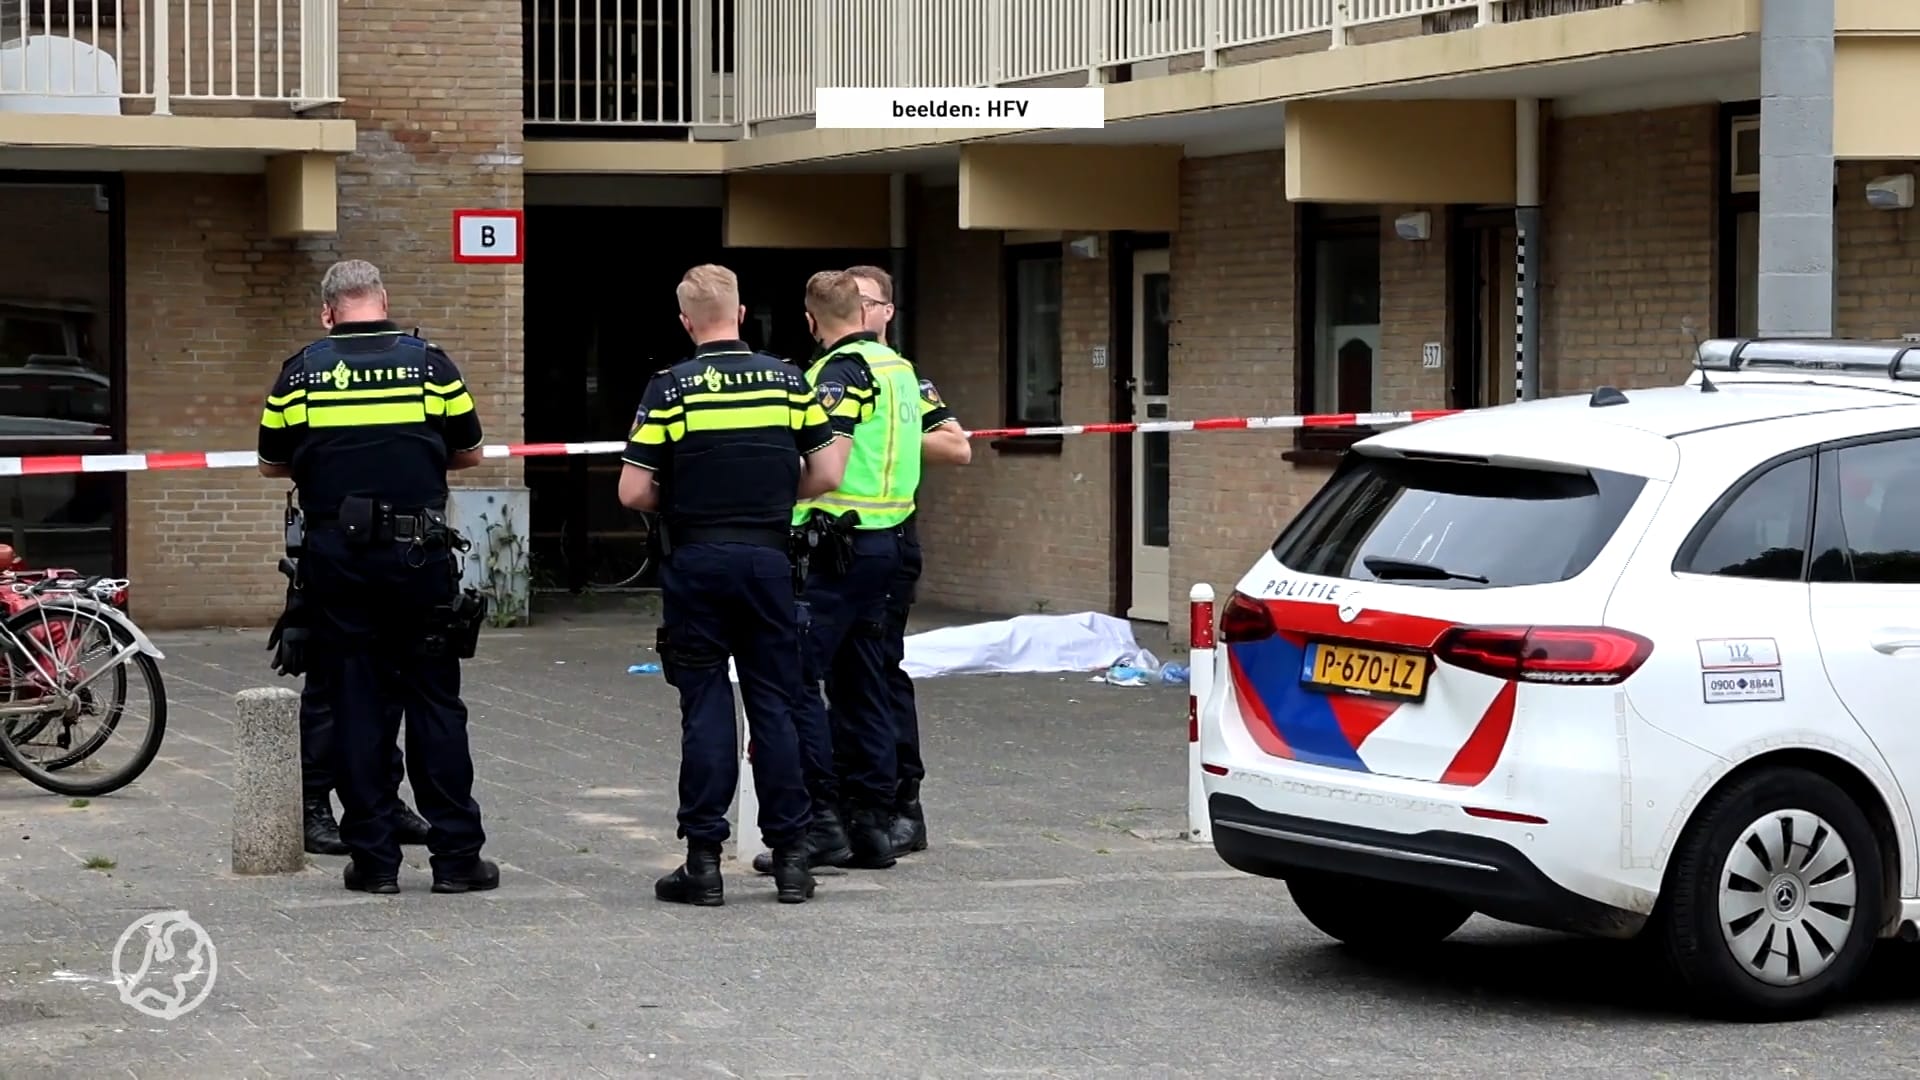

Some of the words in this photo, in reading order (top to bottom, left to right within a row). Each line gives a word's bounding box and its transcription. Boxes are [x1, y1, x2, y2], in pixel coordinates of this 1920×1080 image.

[481, 225, 496, 248] B
[1262, 579, 1341, 600] POLITIE
[1321, 650, 1417, 690] P-670-LZ
[1711, 679, 1735, 690] 0900
[1749, 678, 1774, 689] 8844
